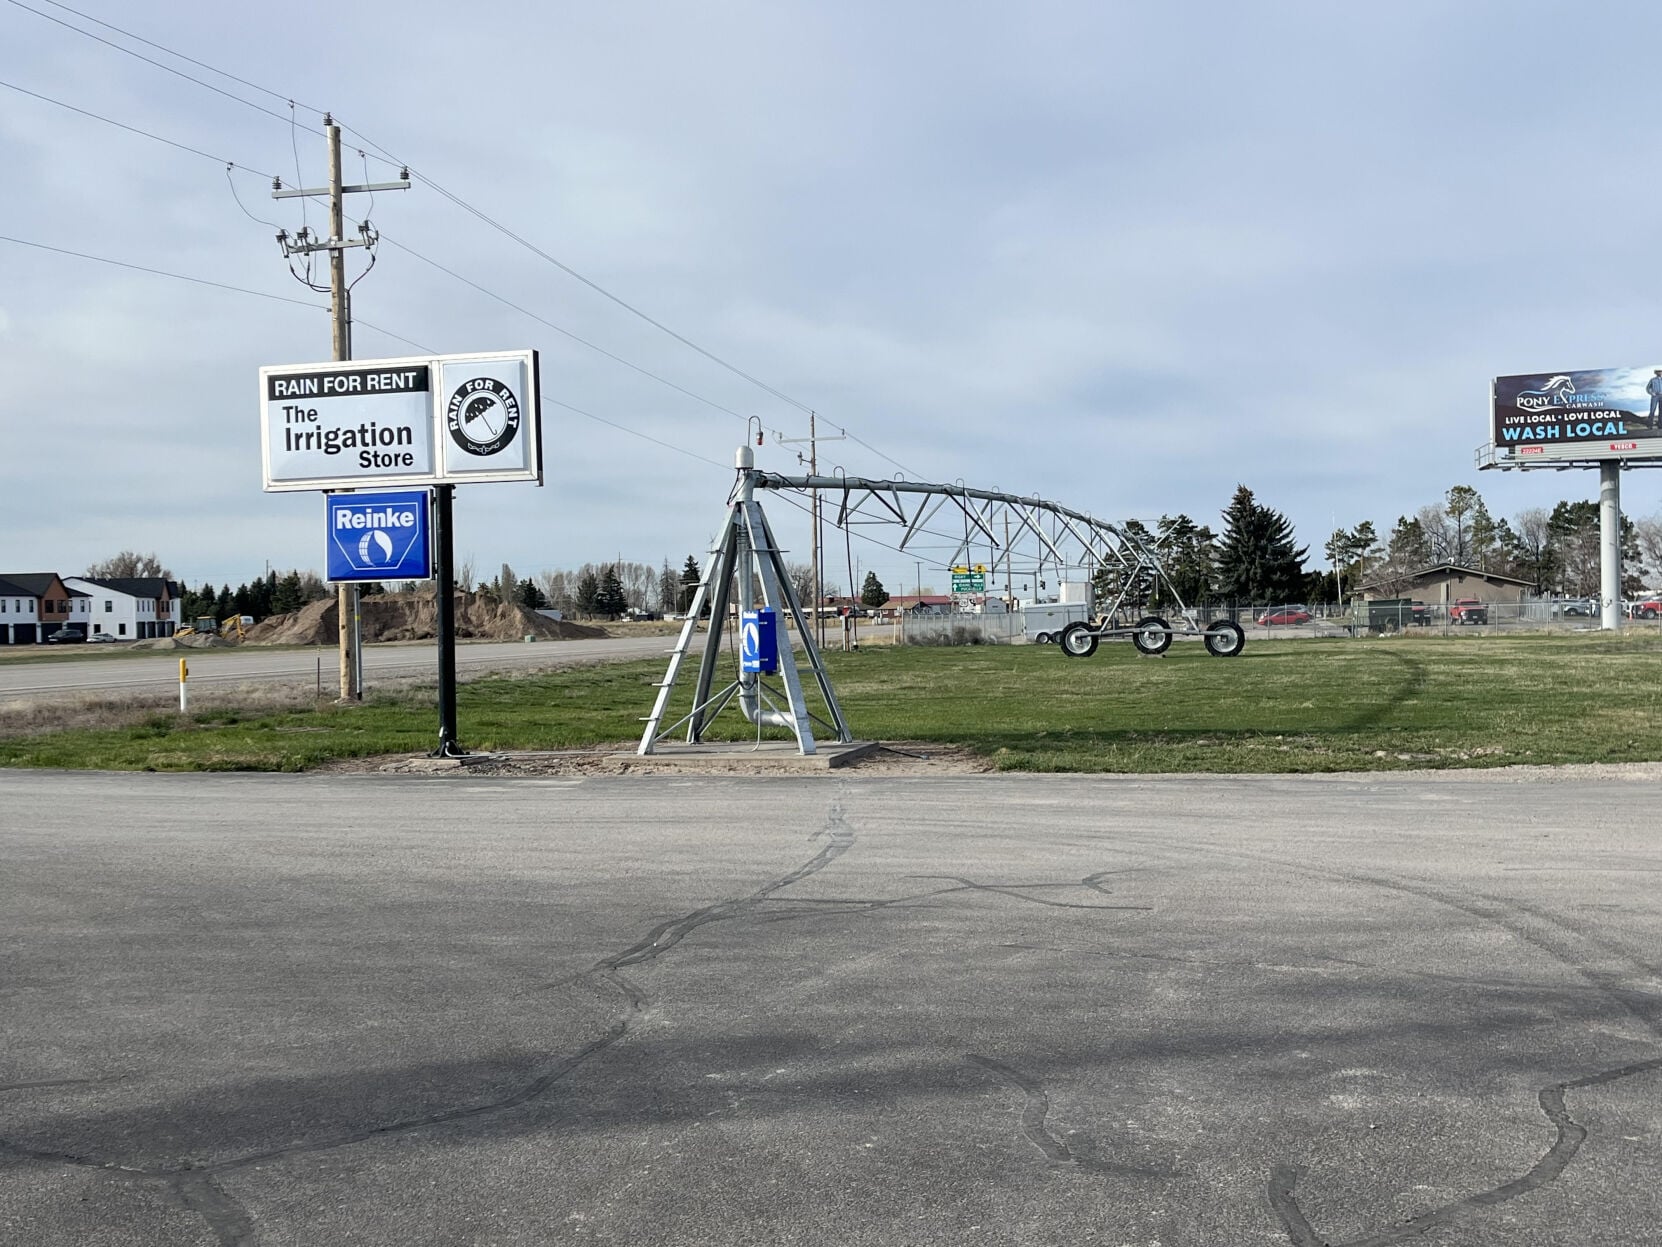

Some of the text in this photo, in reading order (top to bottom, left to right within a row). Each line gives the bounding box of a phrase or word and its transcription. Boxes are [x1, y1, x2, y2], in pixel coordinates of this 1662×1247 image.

[274, 372, 417, 396] RAIN FOR RENT
[448, 379, 518, 431] RAIN FOR RENT
[1517, 396, 1550, 408] PONY
[282, 405, 318, 423] The
[1505, 410, 1621, 425] LIVE LOCAL LOVE LOCAL
[285, 421, 413, 455] Irrigation
[1502, 421, 1628, 441] WASH LOCAL
[359, 450, 414, 469] Store
[336, 507, 415, 530] Reinke
